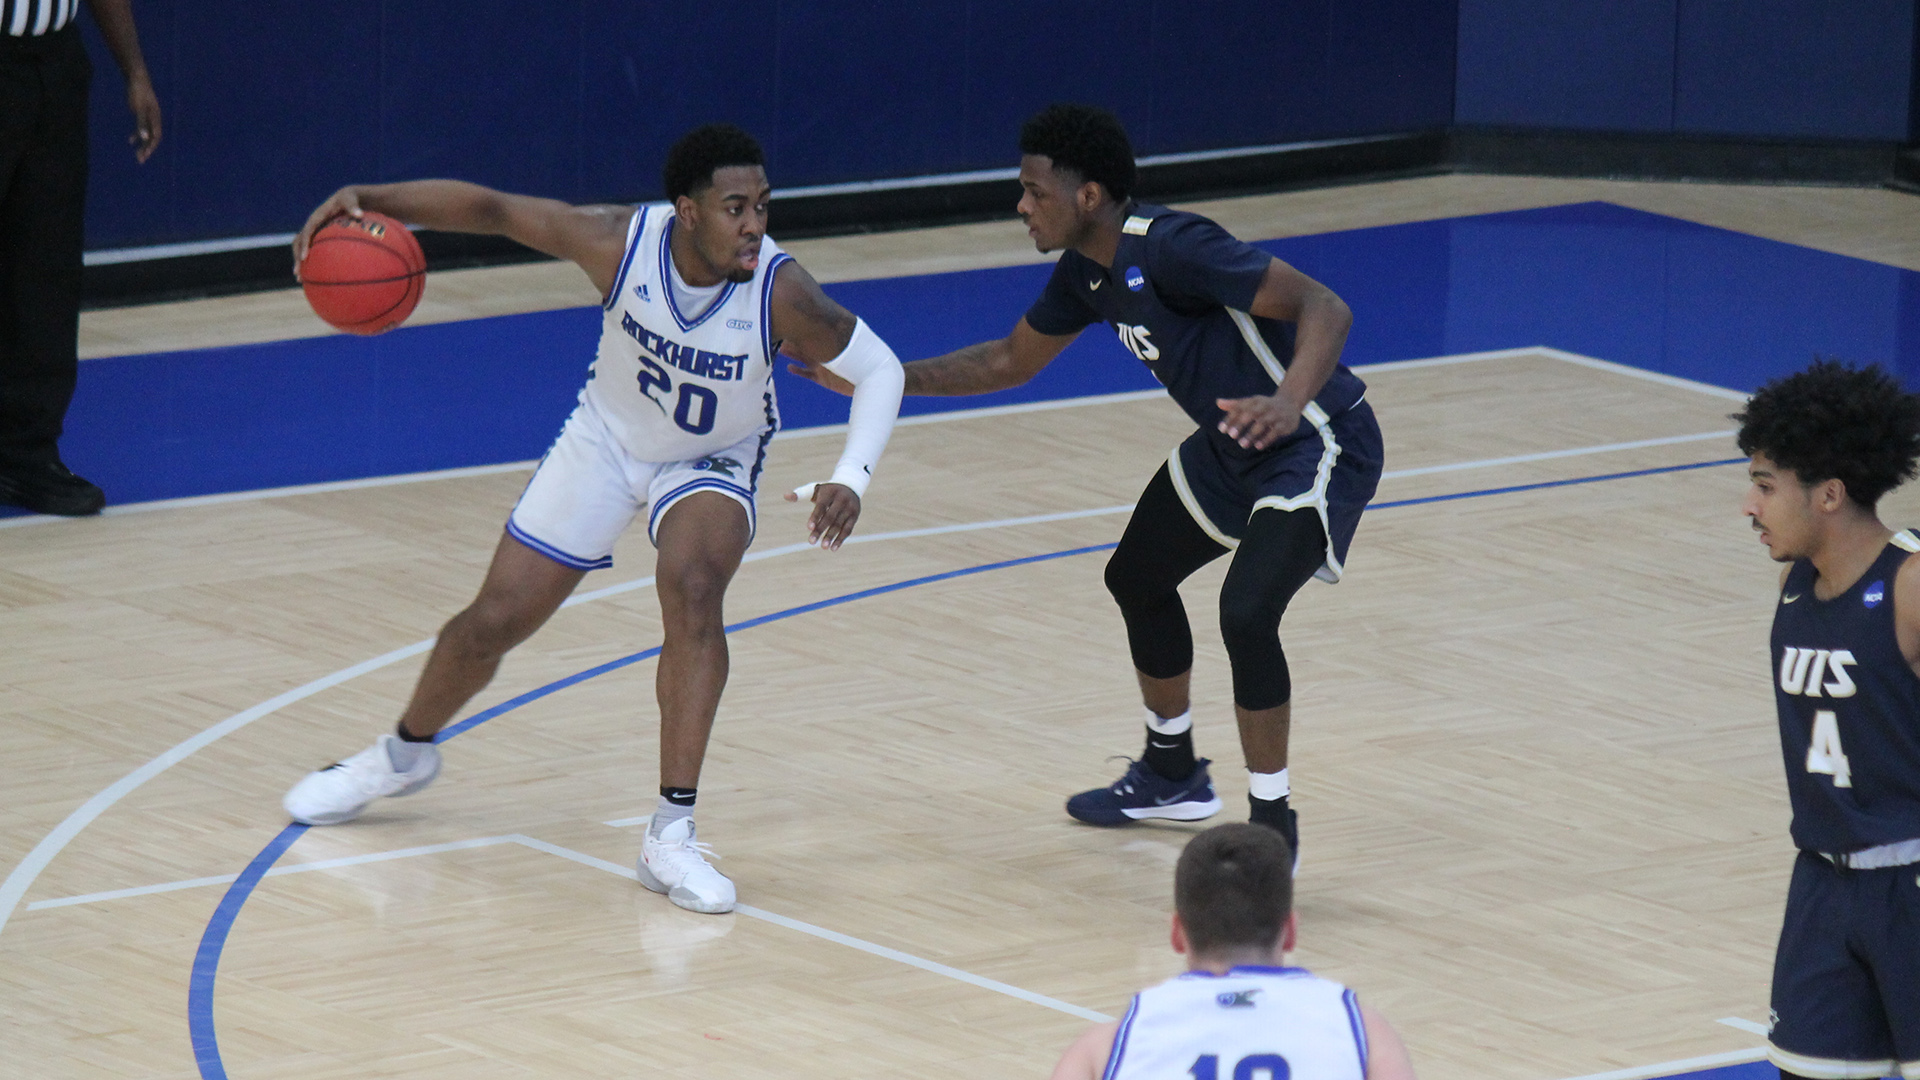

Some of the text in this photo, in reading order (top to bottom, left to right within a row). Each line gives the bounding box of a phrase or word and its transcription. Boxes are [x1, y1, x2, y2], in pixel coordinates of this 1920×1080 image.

[1128, 276, 1145, 288] NCAA
[621, 310, 749, 381] ROCKHURST
[636, 354, 718, 436] 20
[1779, 646, 1858, 698] UIS
[1806, 710, 1853, 788] 4
